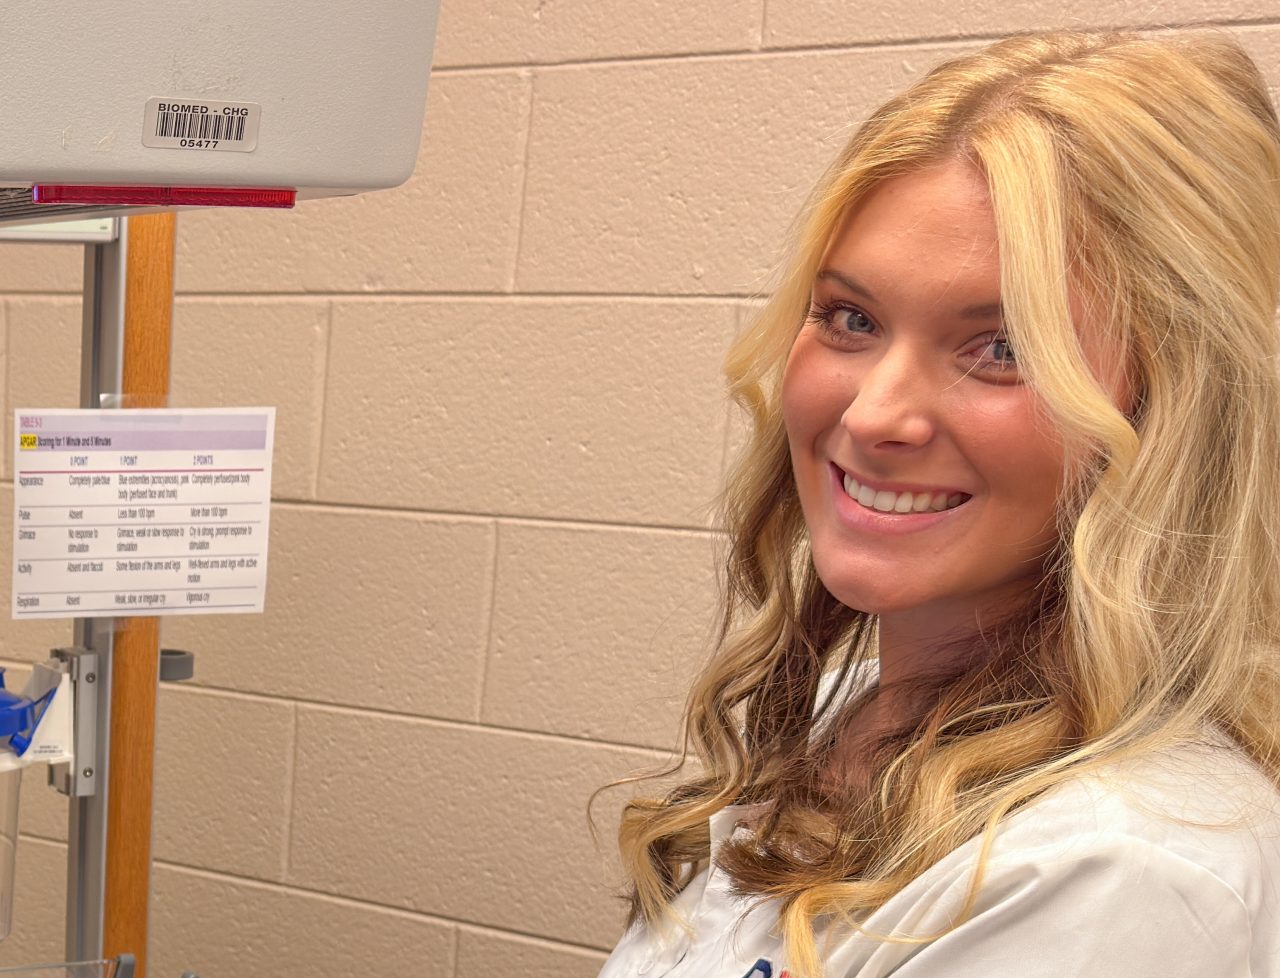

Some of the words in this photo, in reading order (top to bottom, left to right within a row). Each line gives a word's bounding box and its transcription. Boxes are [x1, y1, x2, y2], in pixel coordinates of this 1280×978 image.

[158, 103, 209, 114] BIOMED
[223, 107, 249, 116] CHG
[180, 139, 219, 149] 05477
[38, 437, 54, 449] Scoring
[66, 436, 80, 446] Minute
[95, 436, 111, 446] Minutes
[74, 456, 88, 466] POINT
[124, 456, 137, 465] POINT
